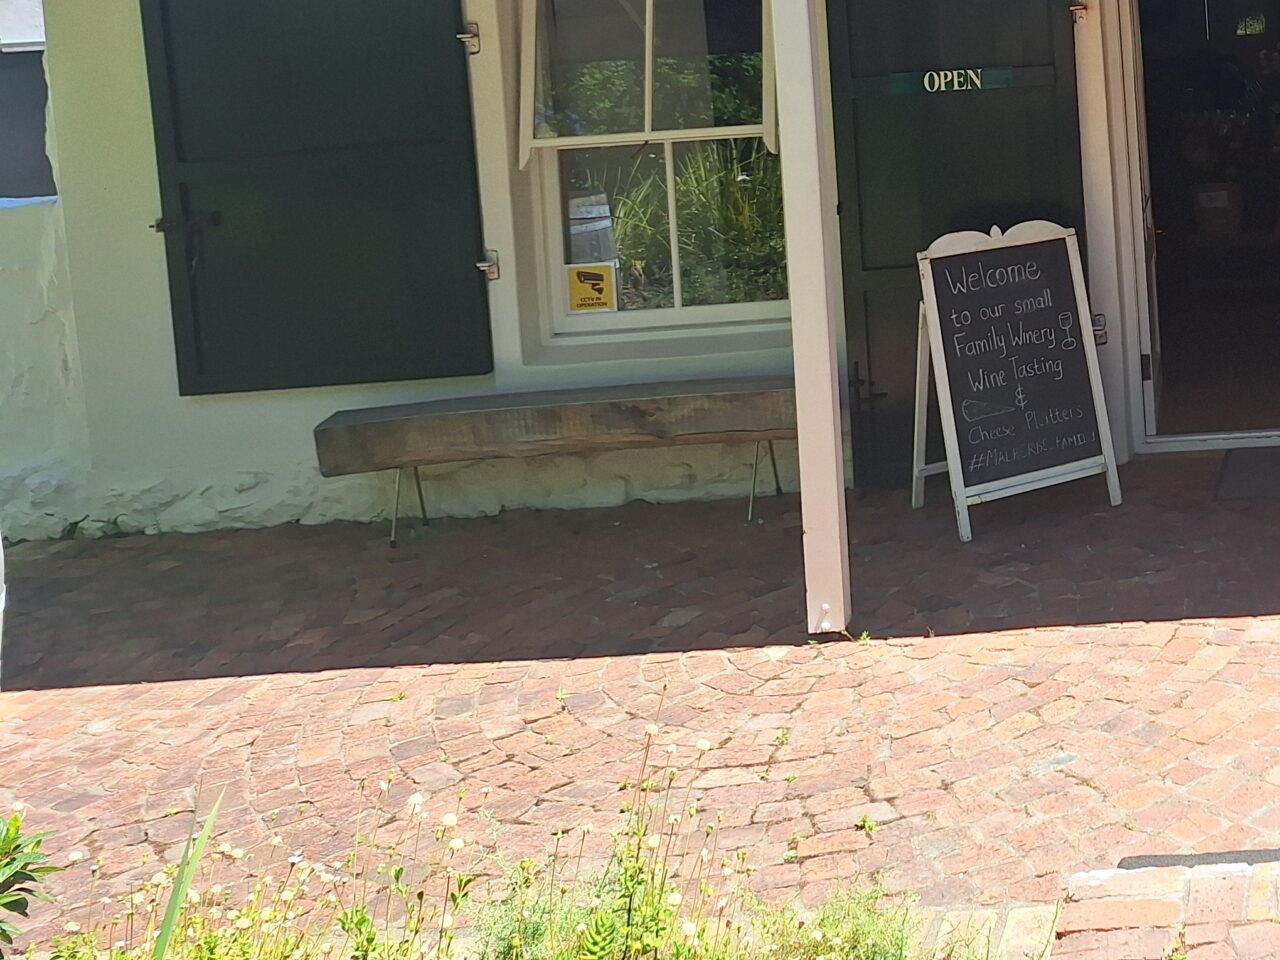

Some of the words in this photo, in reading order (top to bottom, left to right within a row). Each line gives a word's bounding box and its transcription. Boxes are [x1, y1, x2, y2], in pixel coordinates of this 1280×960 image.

[923, 68, 982, 93] OPEN
[945, 261, 1041, 295] Welcome
[950, 308, 971, 327] to
[980, 303, 1005, 320] our
[1014, 287, 1052, 314] small
[953, 325, 1007, 358] Family
[1007, 320, 1056, 349] Winery
[968, 368, 1008, 392] Wine
[1008, 355, 1063, 380] Tasting
[968, 425, 1016, 444] Cheese
